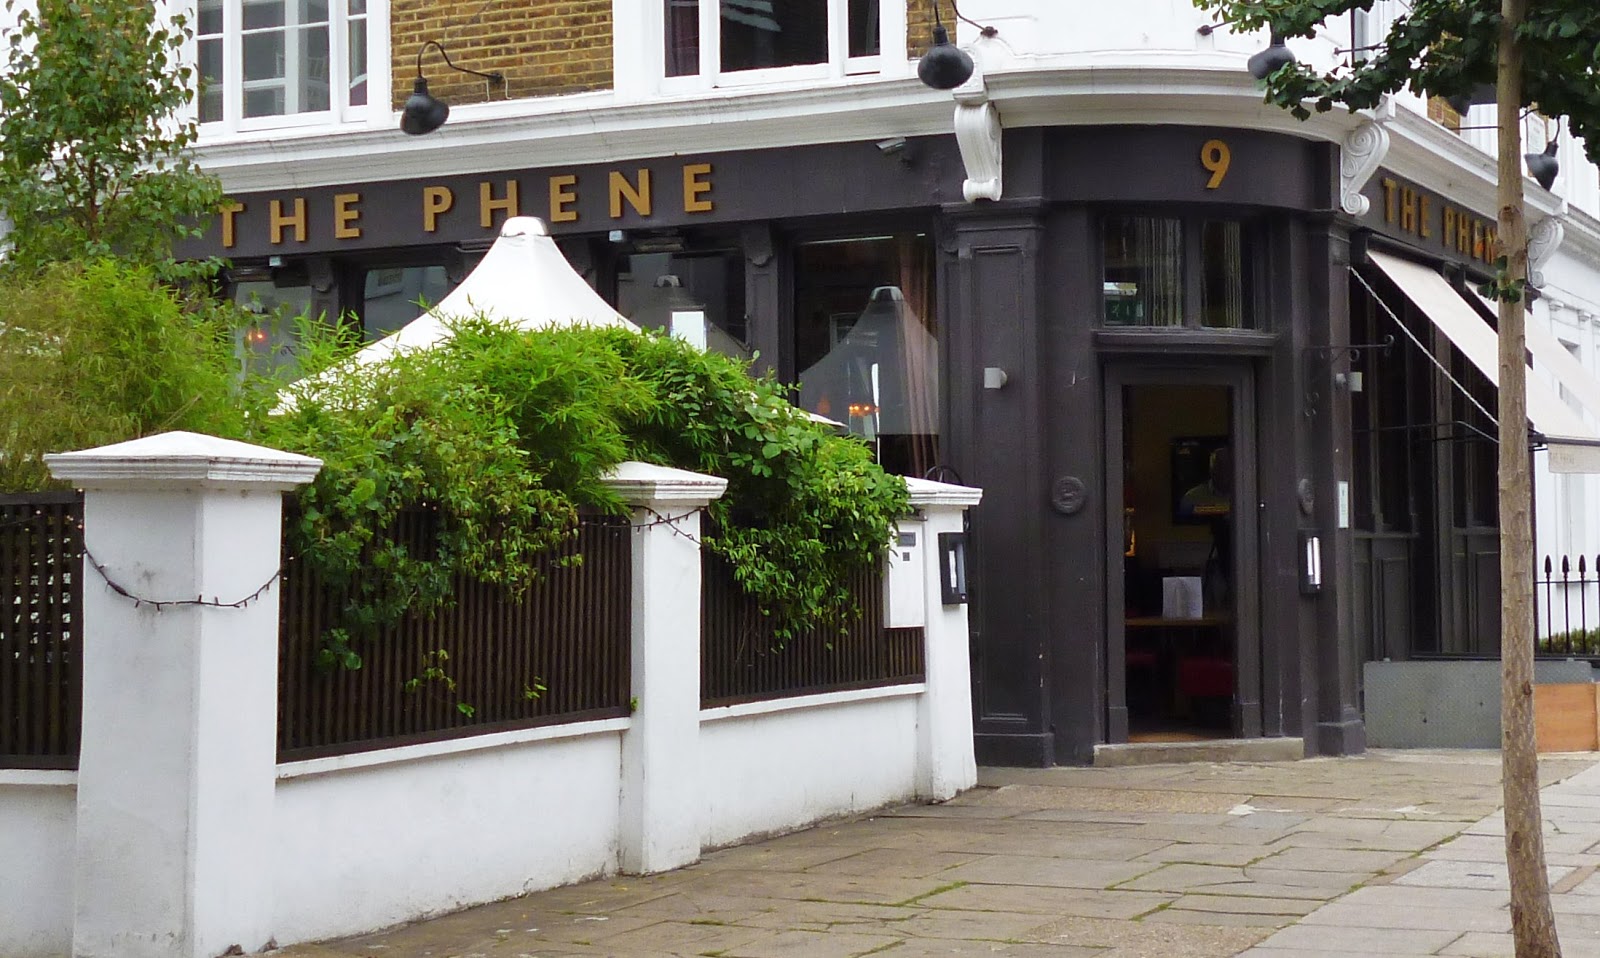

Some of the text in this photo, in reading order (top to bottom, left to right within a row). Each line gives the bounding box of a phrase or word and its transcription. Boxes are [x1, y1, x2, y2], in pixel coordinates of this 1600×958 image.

[219, 163, 713, 248] THE PHENE
[1201, 139, 1231, 189] 9
[1383, 177, 1499, 265] THE PHEN
